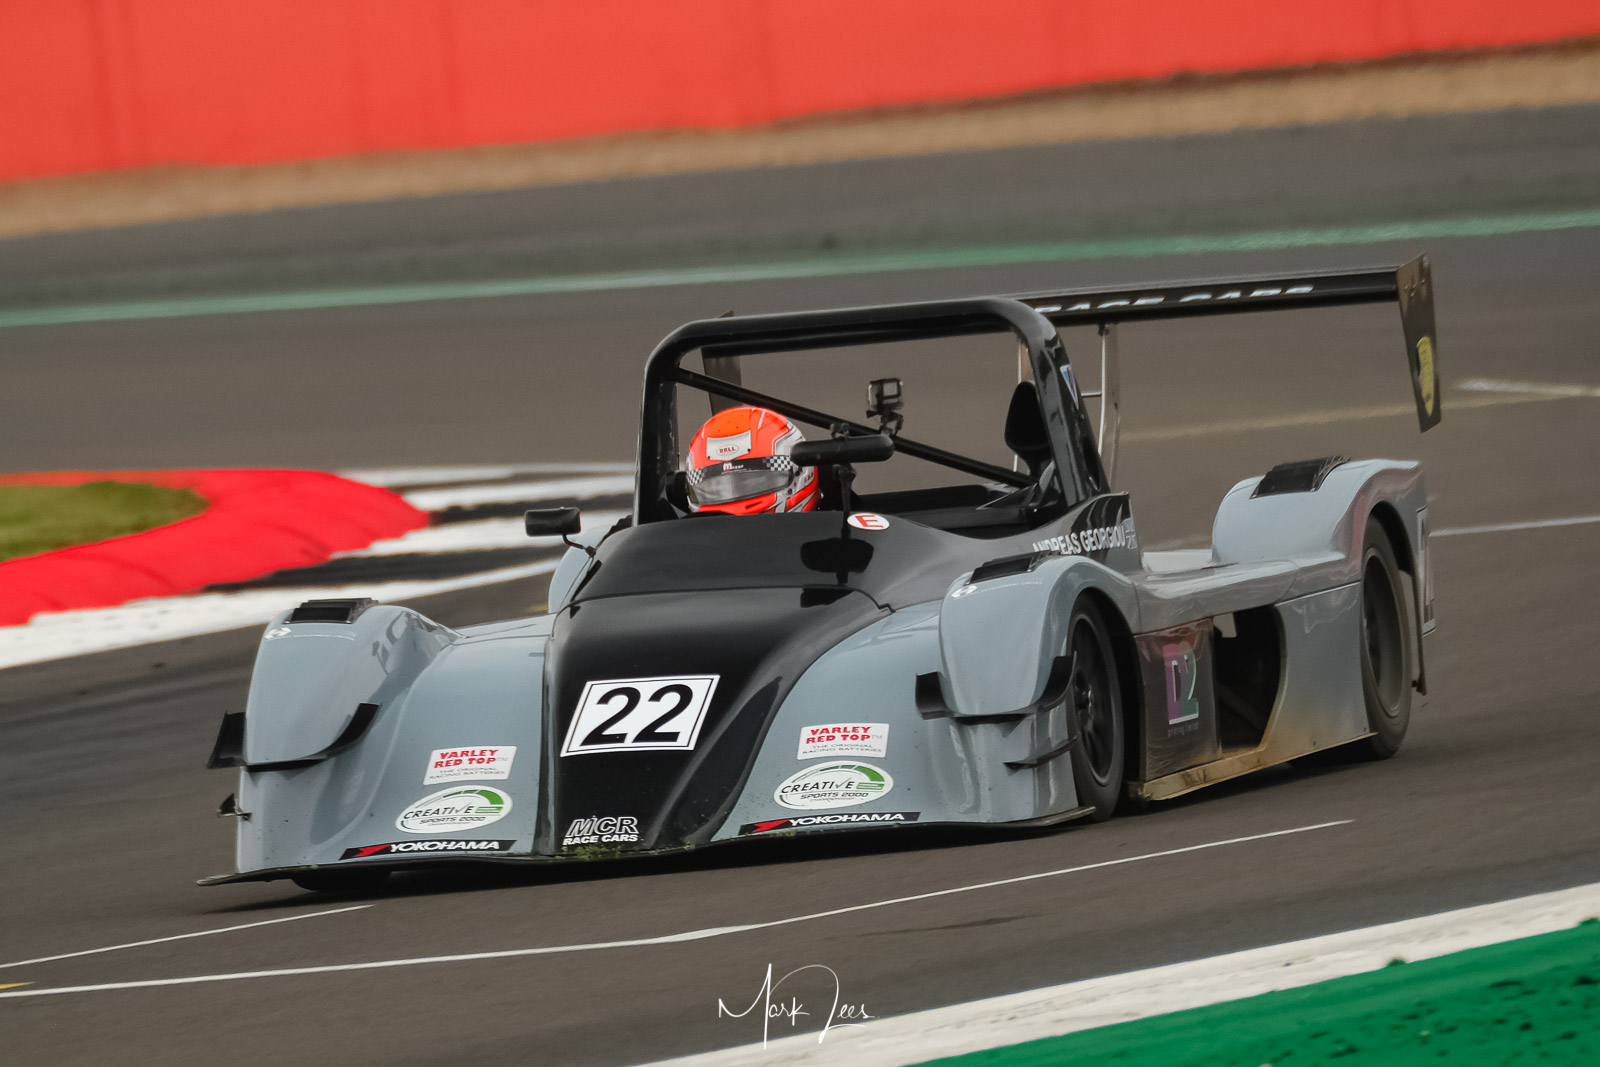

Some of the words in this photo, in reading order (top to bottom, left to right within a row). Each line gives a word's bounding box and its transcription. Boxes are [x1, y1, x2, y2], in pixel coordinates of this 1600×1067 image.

[855, 514, 884, 528] E
[579, 683, 694, 747] 22
[810, 726, 872, 736] VARLEY
[805, 735, 836, 745] RED
[440, 749, 499, 760] VARLEY
[433, 759, 463, 769] RED
[781, 778, 855, 794] CREATIVE
[800, 792, 839, 800] SPORTS
[403, 803, 475, 820] CREATIVE
[418, 816, 457, 825] SPORTS
[789, 813, 905, 827] YOKOHAMA
[565, 816, 639, 838] MCR
[562, 835, 599, 846] RACE
[601, 834, 639, 843] CARS
[390, 841, 501, 853] YOKOHAMA
